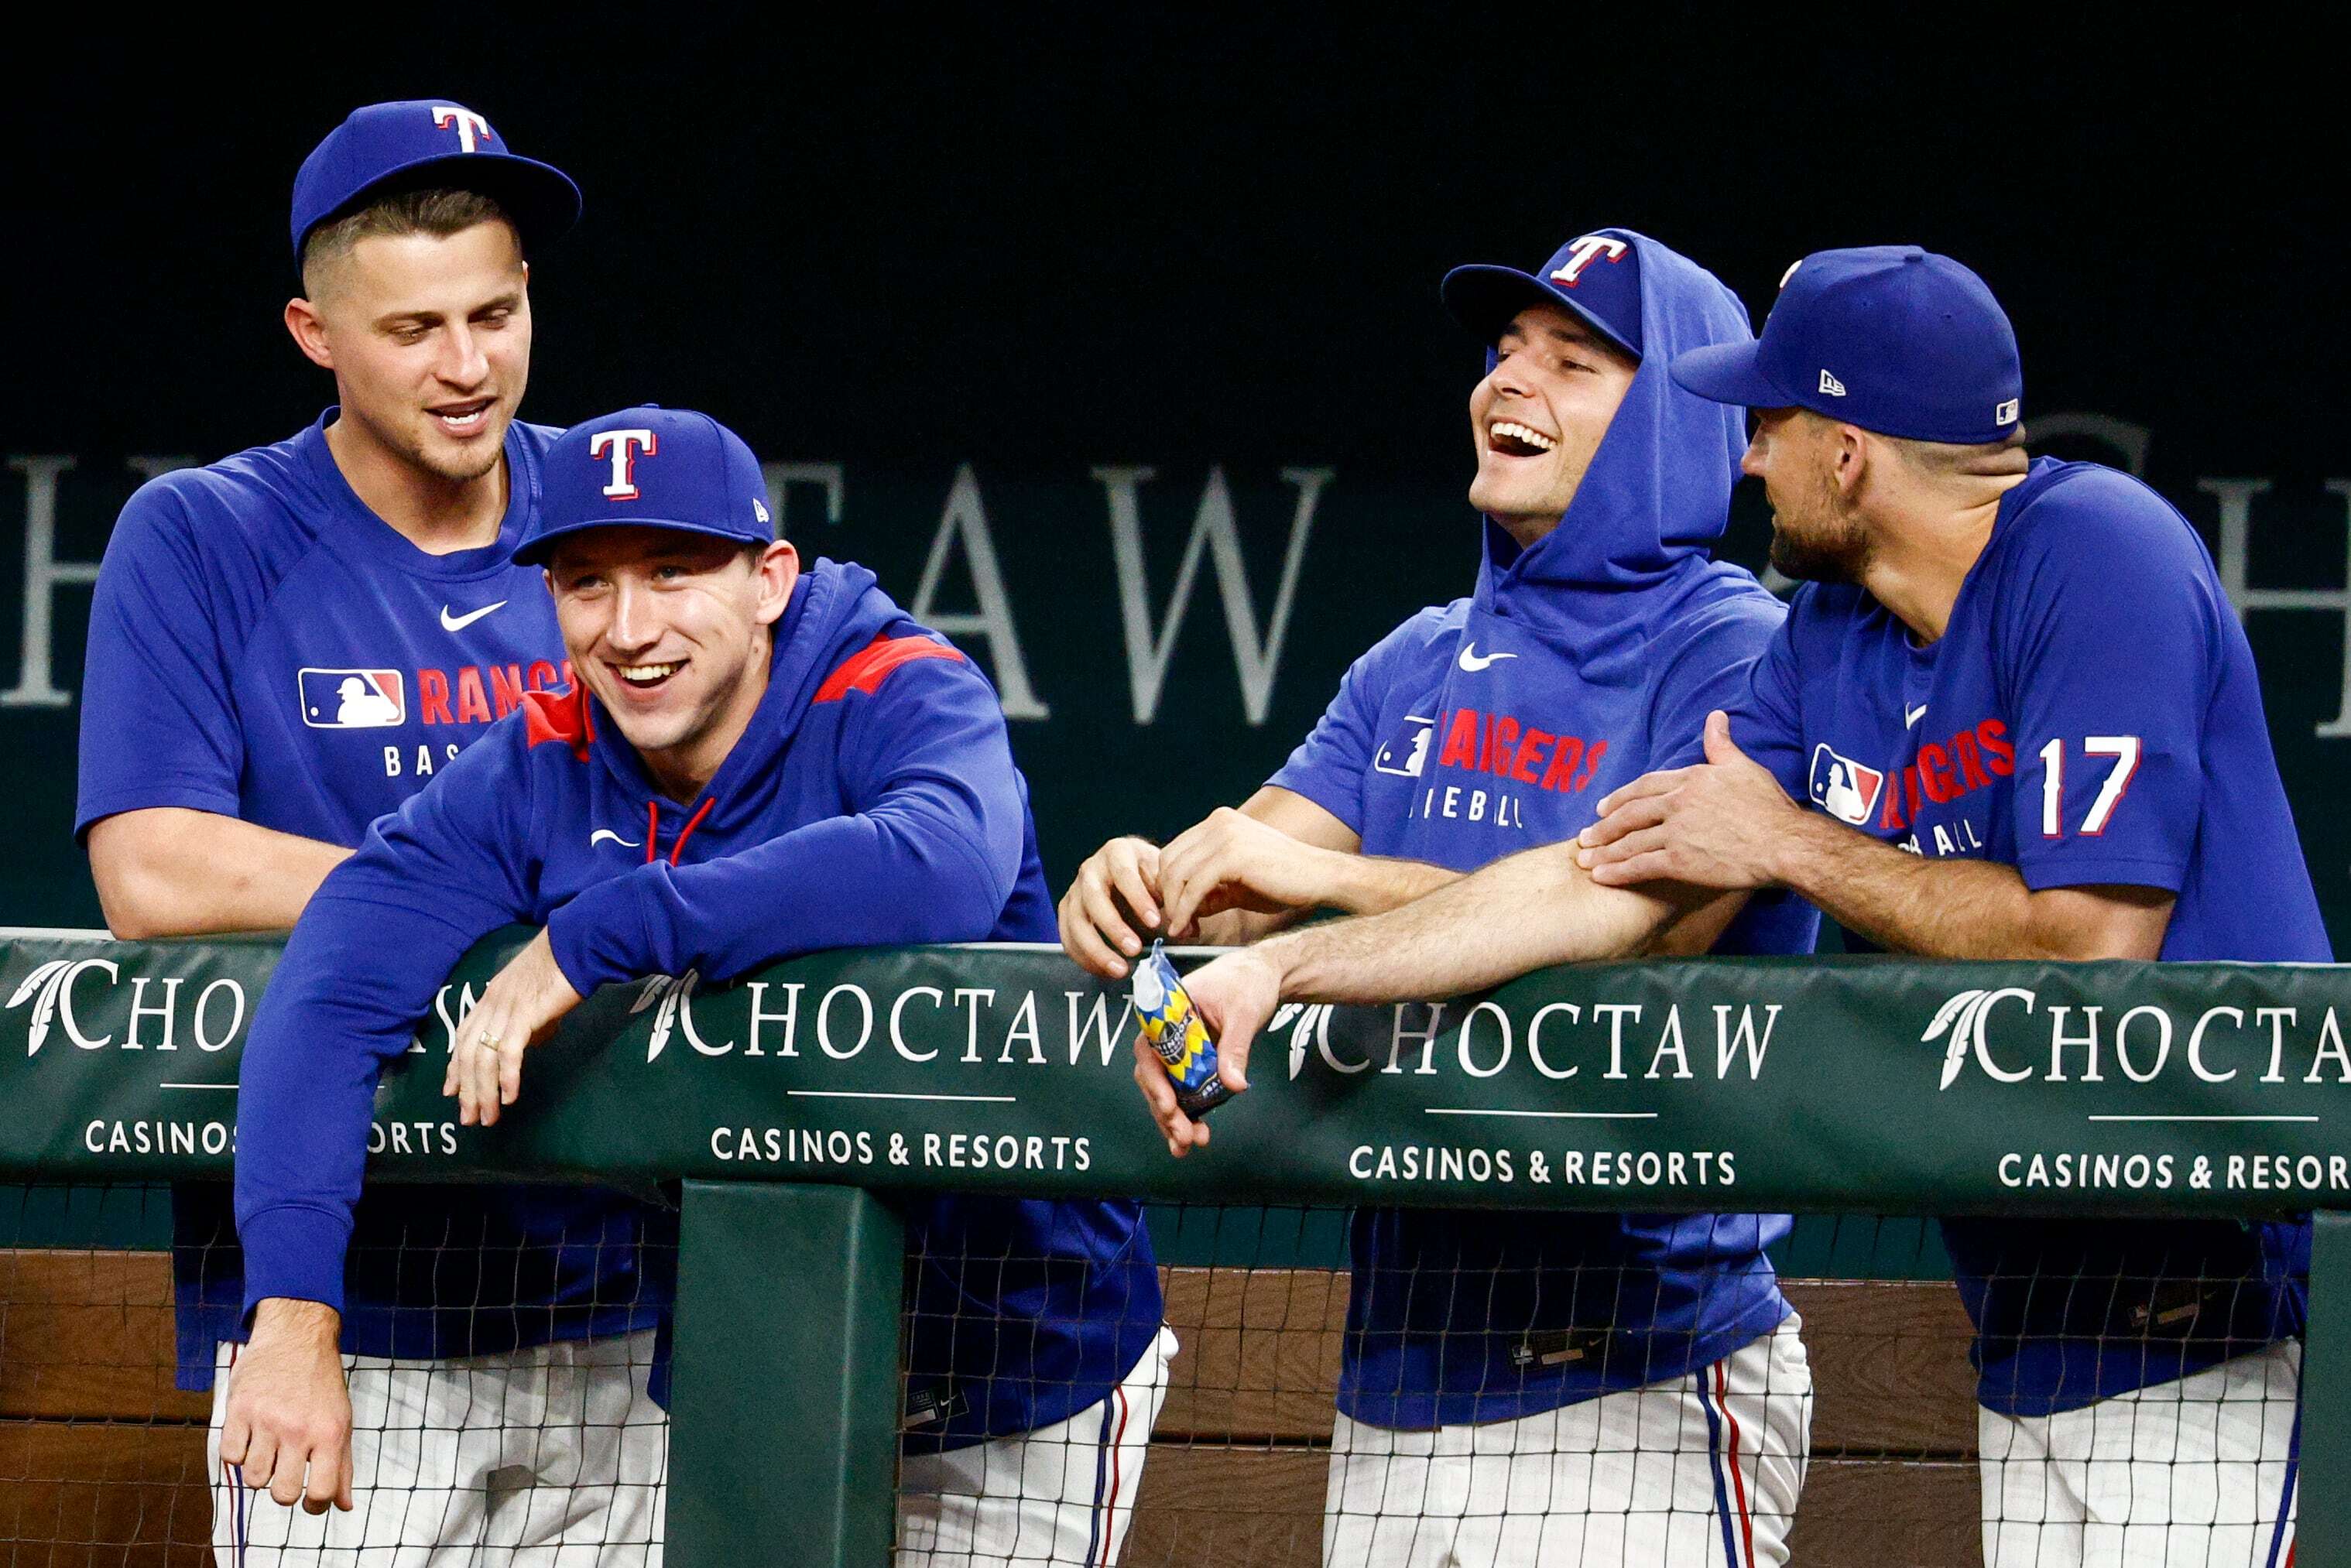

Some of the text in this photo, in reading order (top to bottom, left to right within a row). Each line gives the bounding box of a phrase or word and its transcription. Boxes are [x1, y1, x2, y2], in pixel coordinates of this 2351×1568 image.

[431, 106, 490, 153] T
[1550, 236, 1630, 289] T
[590, 430, 656, 501] T
[2039, 735, 2143, 839] 17
[1317, 1002, 1783, 1080] CHOCTAW
[85, 1119, 458, 1155] CASINO ORTS
[711, 1127, 1090, 1171] CASINOS & RESORTS
[1349, 1145, 1735, 1186] CASINOS & RESORTS
[1998, 1152, 2174, 1188] CASINOS
[2188, 1155, 2212, 1189] &
